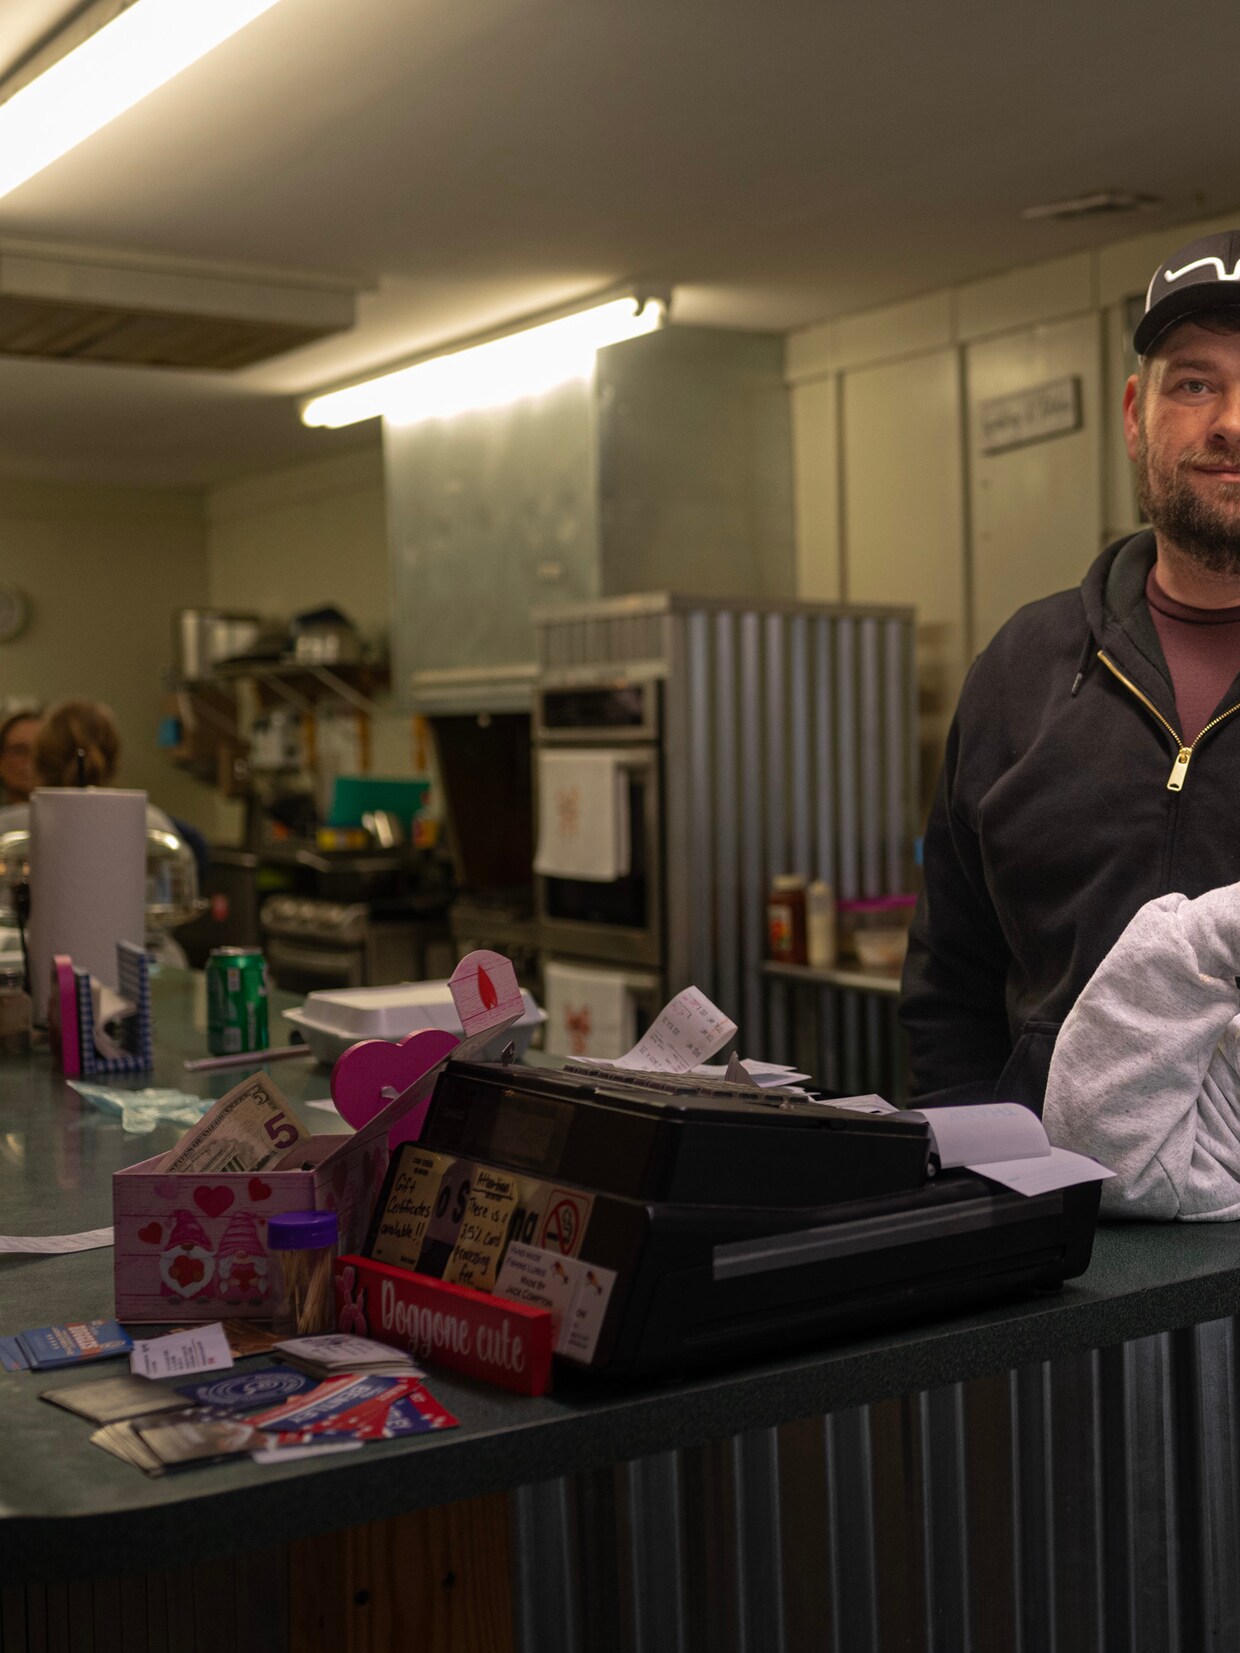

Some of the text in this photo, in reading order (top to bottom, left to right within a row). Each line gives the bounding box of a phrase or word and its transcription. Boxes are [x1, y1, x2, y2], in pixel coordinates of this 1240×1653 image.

[264, 1112, 299, 1149] 5
[394, 1172, 416, 1192] Gift
[467, 1196, 488, 1218] There
[491, 1208, 500, 1223] is
[380, 1279, 527, 1373] Doggone cute
